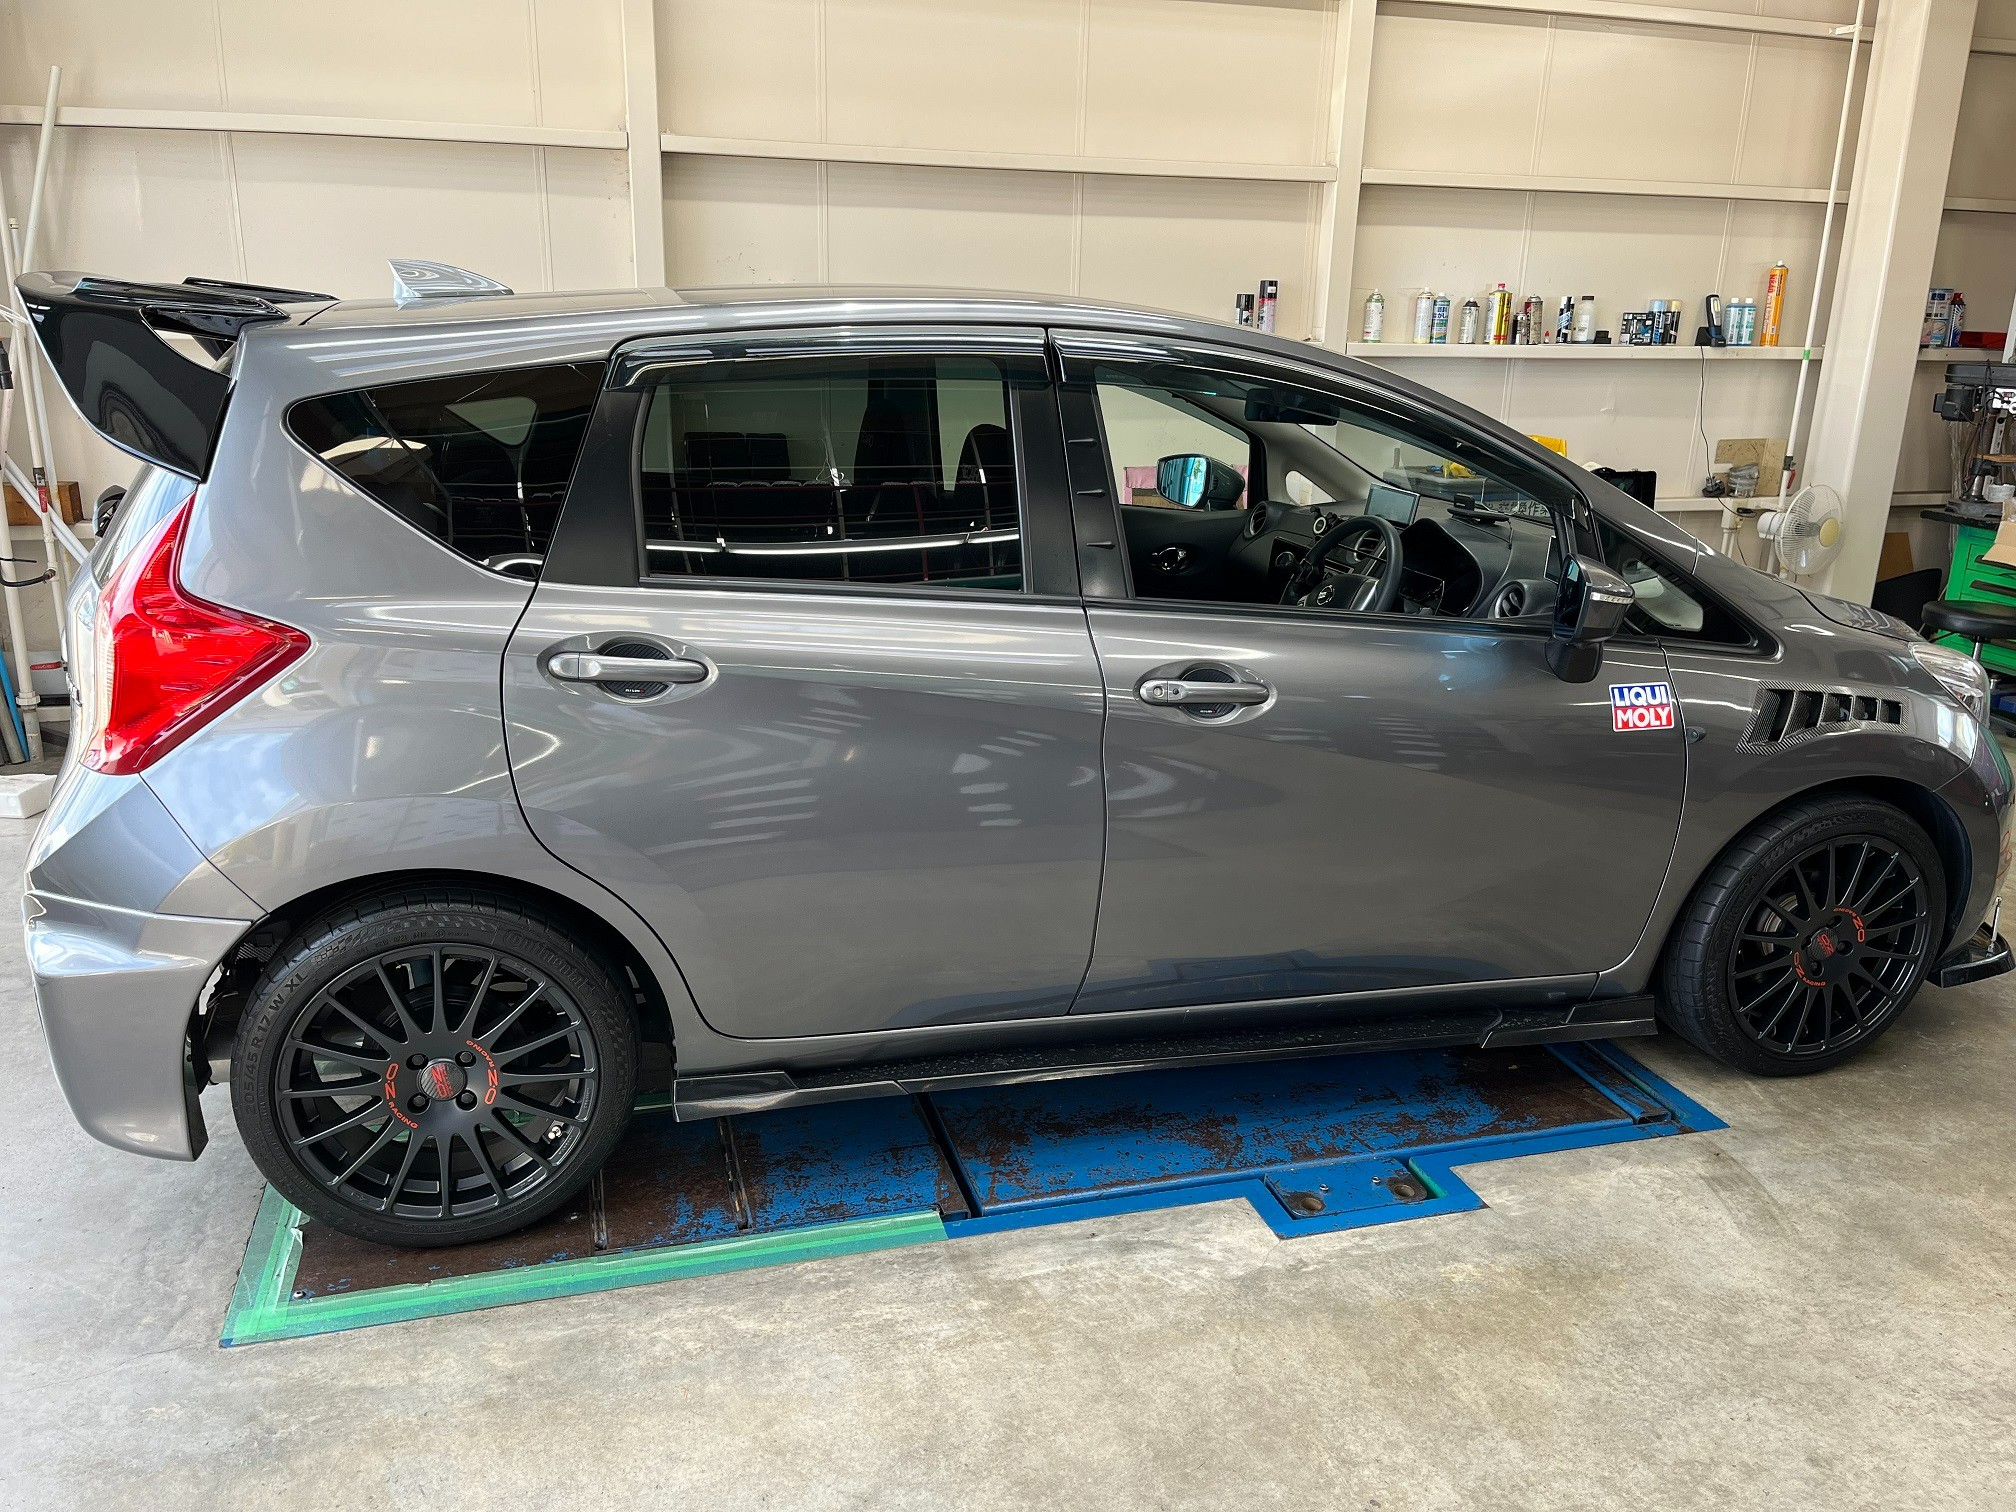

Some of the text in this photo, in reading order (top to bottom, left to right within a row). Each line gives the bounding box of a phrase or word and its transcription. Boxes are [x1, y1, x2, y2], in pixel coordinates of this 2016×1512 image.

[1613, 686, 1668, 706] LIQUI
[1616, 707, 1670, 728] MOLY
[1803, 977, 1825, 986] RACING
[244, 1051, 259, 1117] 205/45
[268, 993, 285, 1011] W
[284, 972, 309, 993] XL
[465, 1039, 495, 1068] RACING
[388, 1101, 419, 1129] RACING
